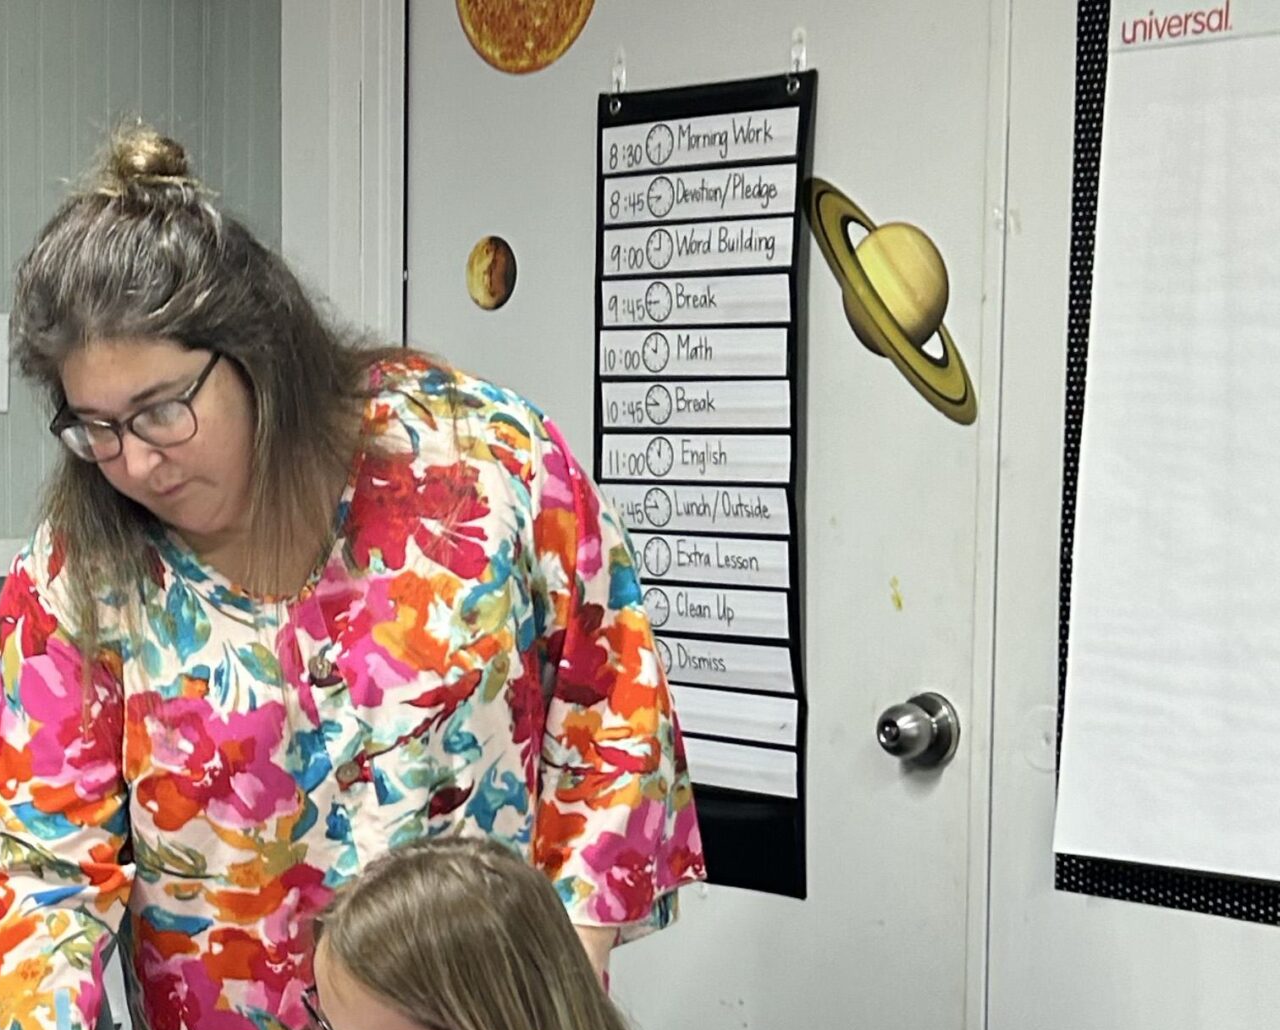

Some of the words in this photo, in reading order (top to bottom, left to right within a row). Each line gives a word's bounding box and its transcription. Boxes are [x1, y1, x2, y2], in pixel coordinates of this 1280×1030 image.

[1121, 0, 1230, 44] universal
[609, 142, 642, 169] 8:30
[677, 123, 728, 158] Morning
[732, 116, 773, 145] Work
[609, 190, 644, 219] 8:45
[675, 172, 778, 209] Devotion/Pledge
[610, 244, 644, 272] 9:00
[675, 228, 711, 257] Word
[719, 226, 775, 260] Building
[608, 294, 645, 322] 9:45
[675, 282, 717, 310] Break
[603, 346, 641, 373] 10:00
[676, 334, 713, 362] Math
[606, 399, 644, 424] 10:45
[675, 386, 716, 413] Break
[608, 449, 645, 476] 11:00
[681, 439, 727, 475] English
[674, 489, 770, 524] Lunch/Outside
[676, 538, 711, 567] Extra
[716, 541, 760, 572] Lesson
[676, 591, 711, 619] Clean
[716, 594, 735, 626] Up
[677, 643, 727, 672] Dismiss
